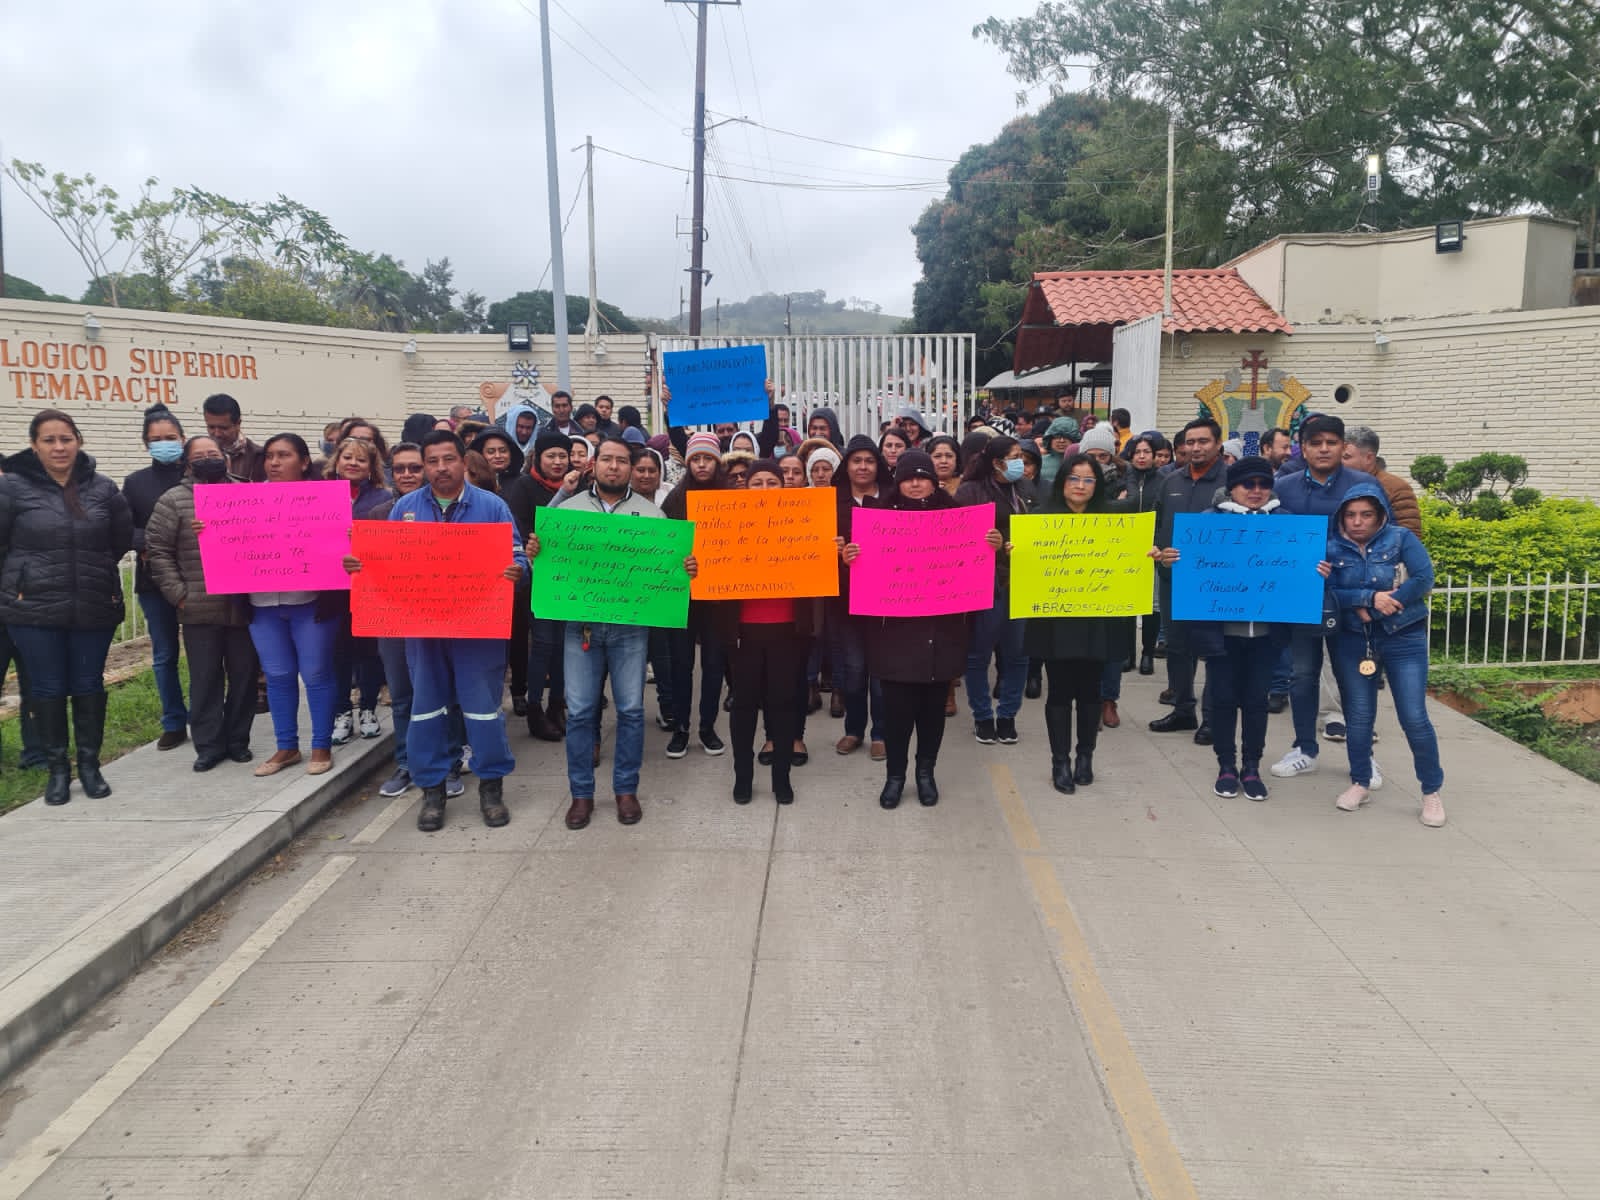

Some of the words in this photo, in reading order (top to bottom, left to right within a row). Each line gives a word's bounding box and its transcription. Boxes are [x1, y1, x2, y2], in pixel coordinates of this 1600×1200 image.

[0, 339, 107, 372] LOGICO
[129, 348, 258, 380] SUPERIOR
[9, 371, 179, 404] TEMAPACHE
